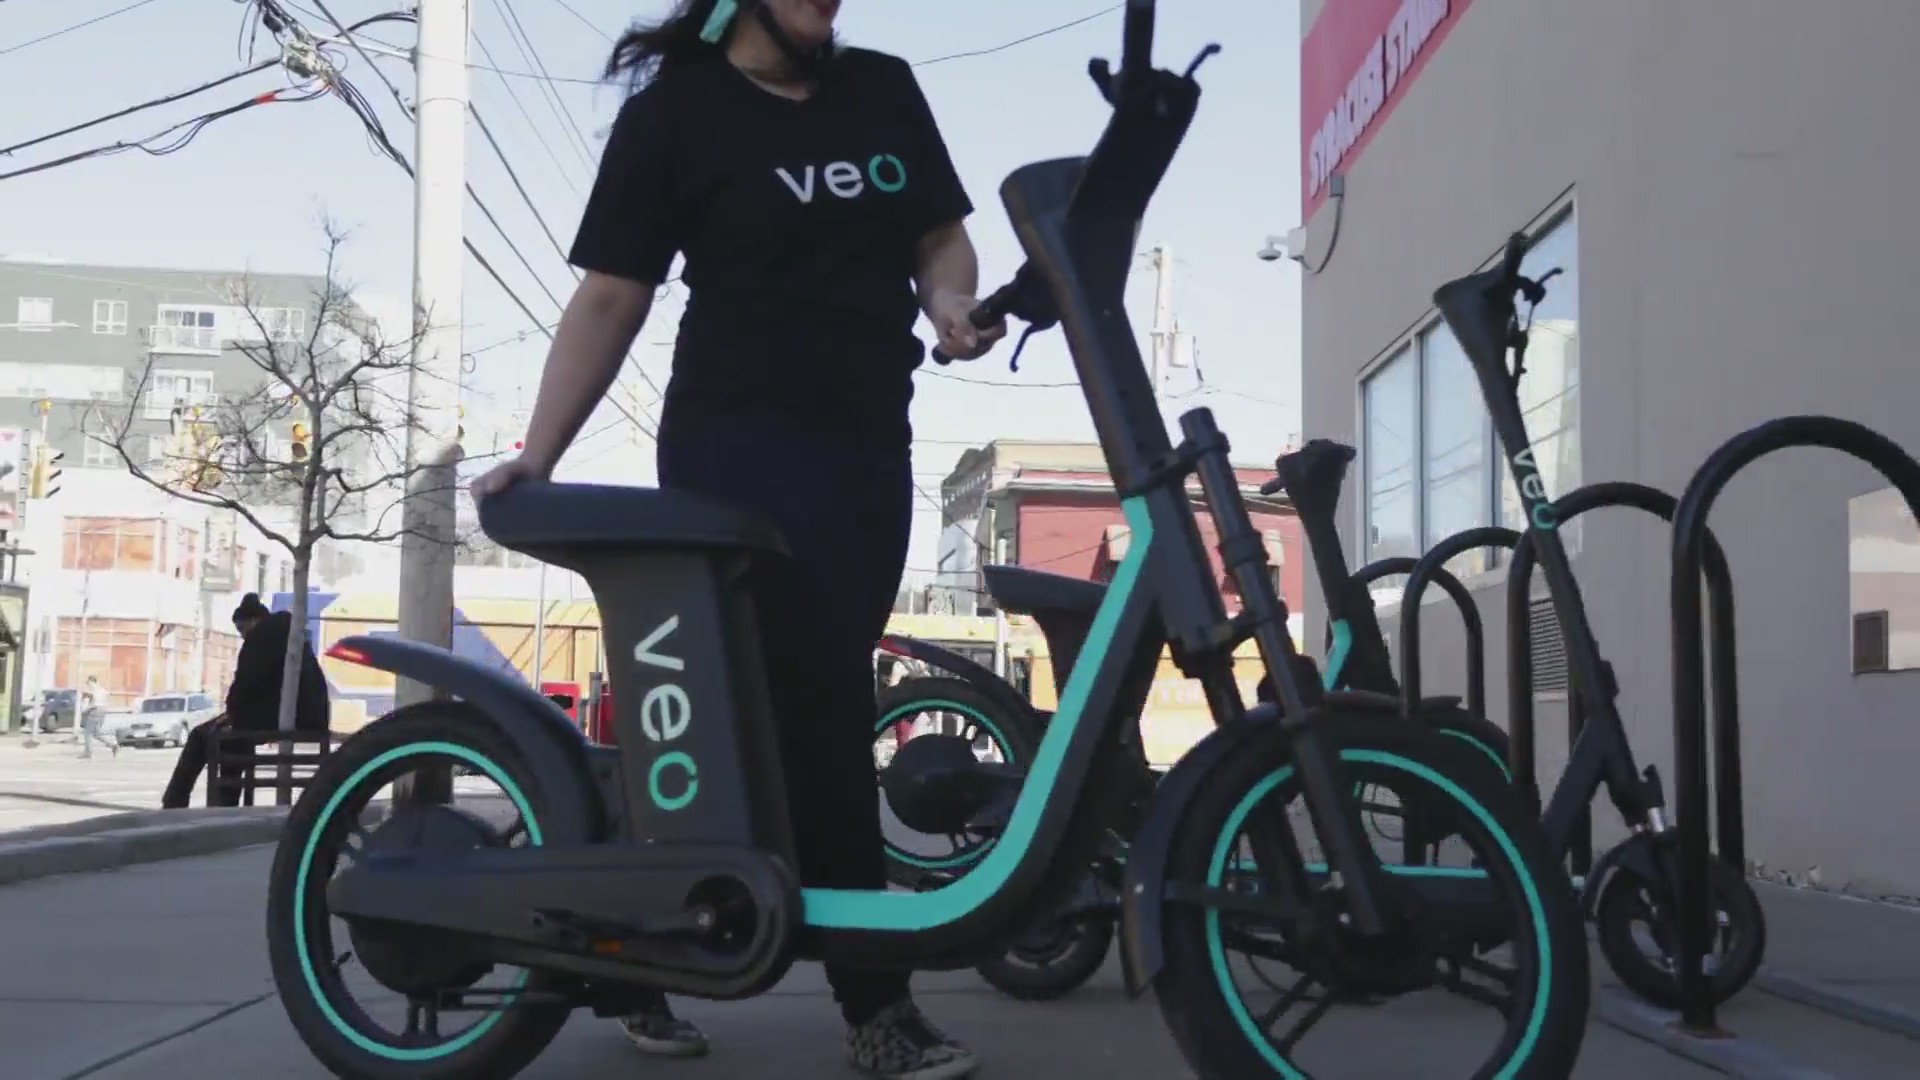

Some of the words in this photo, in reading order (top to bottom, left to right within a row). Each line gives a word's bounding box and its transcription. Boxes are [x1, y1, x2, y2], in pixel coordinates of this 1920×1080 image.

[774, 154, 906, 204] veo
[1514, 448, 1557, 529] veo
[634, 614, 698, 811] veo
